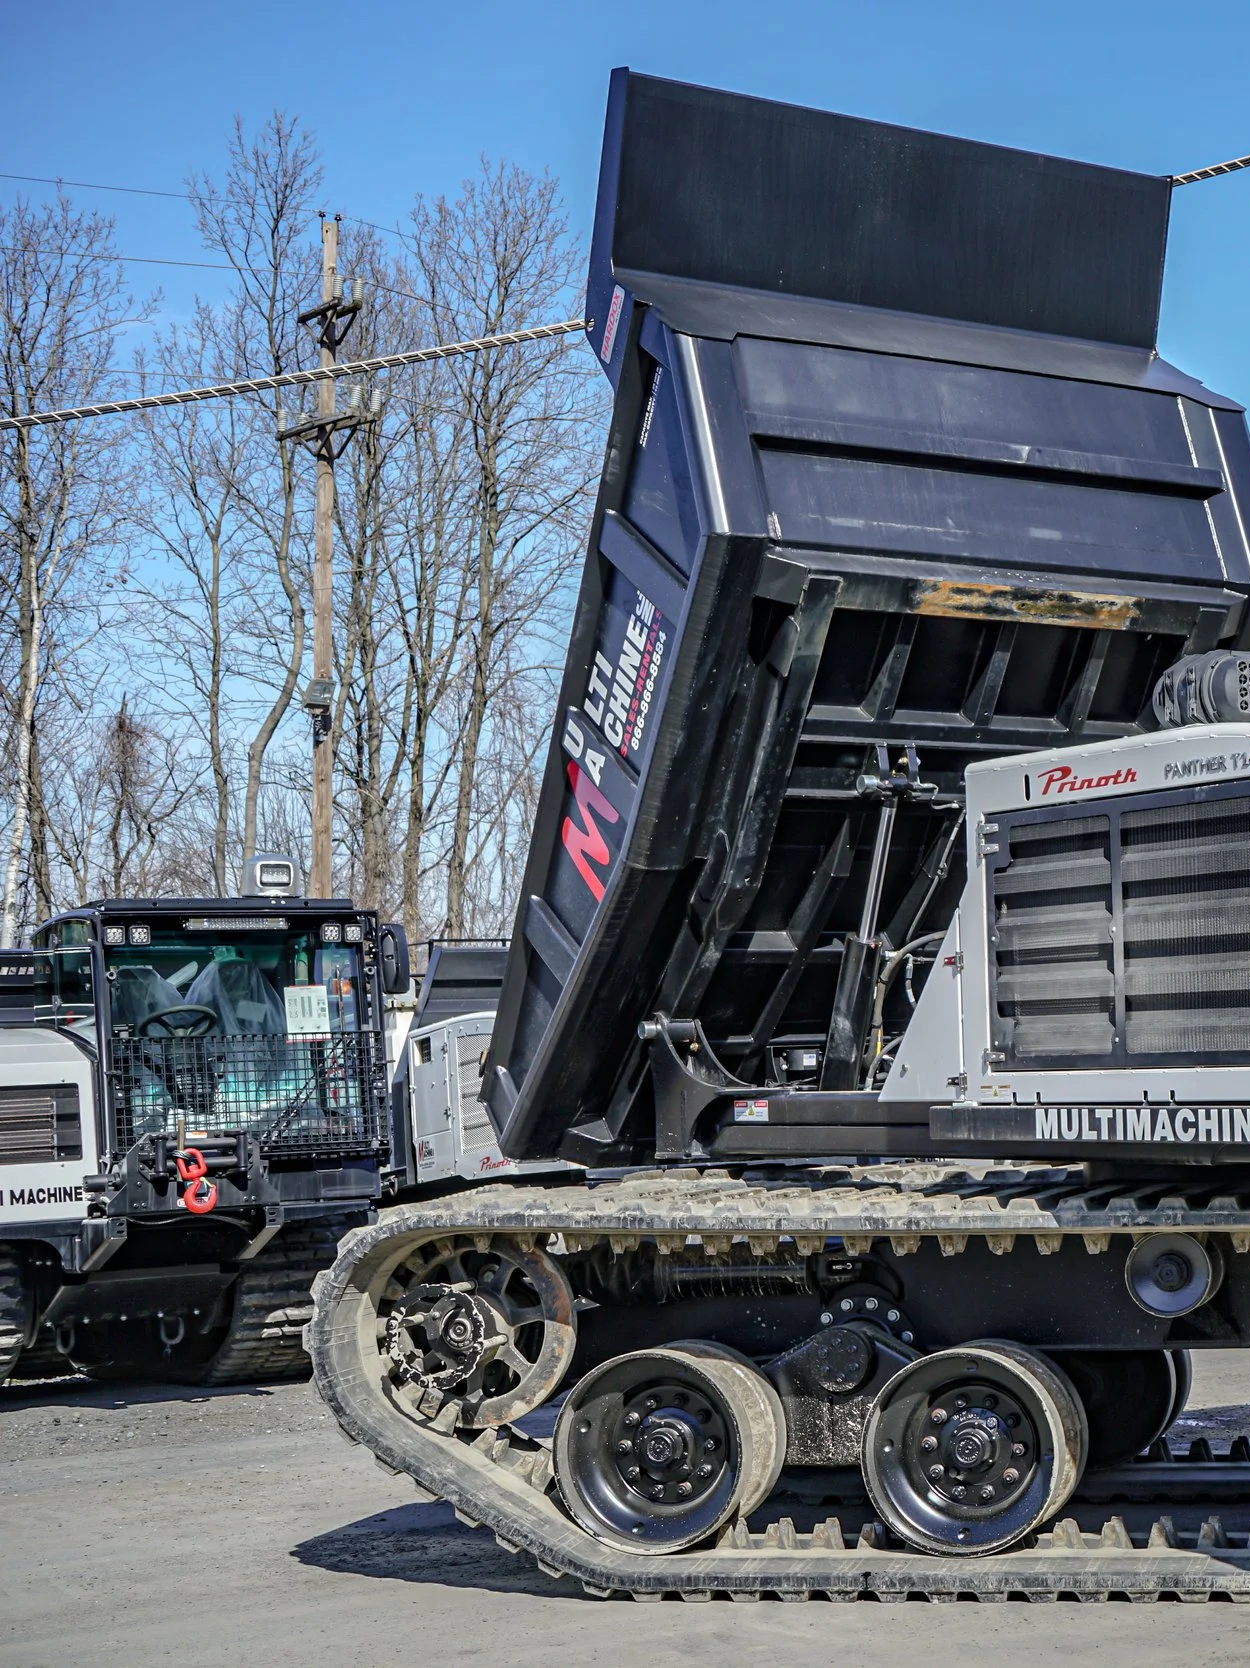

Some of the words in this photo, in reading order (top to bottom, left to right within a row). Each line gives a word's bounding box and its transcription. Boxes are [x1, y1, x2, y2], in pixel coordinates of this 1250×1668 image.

[602, 293, 620, 358] HARDOX
[631, 631, 667, 750] 866-866-8584
[1037, 765, 1137, 795] Prinoth
[1164, 756, 1227, 780] PANTHER
[10, 1186, 83, 1206] MACHINE
